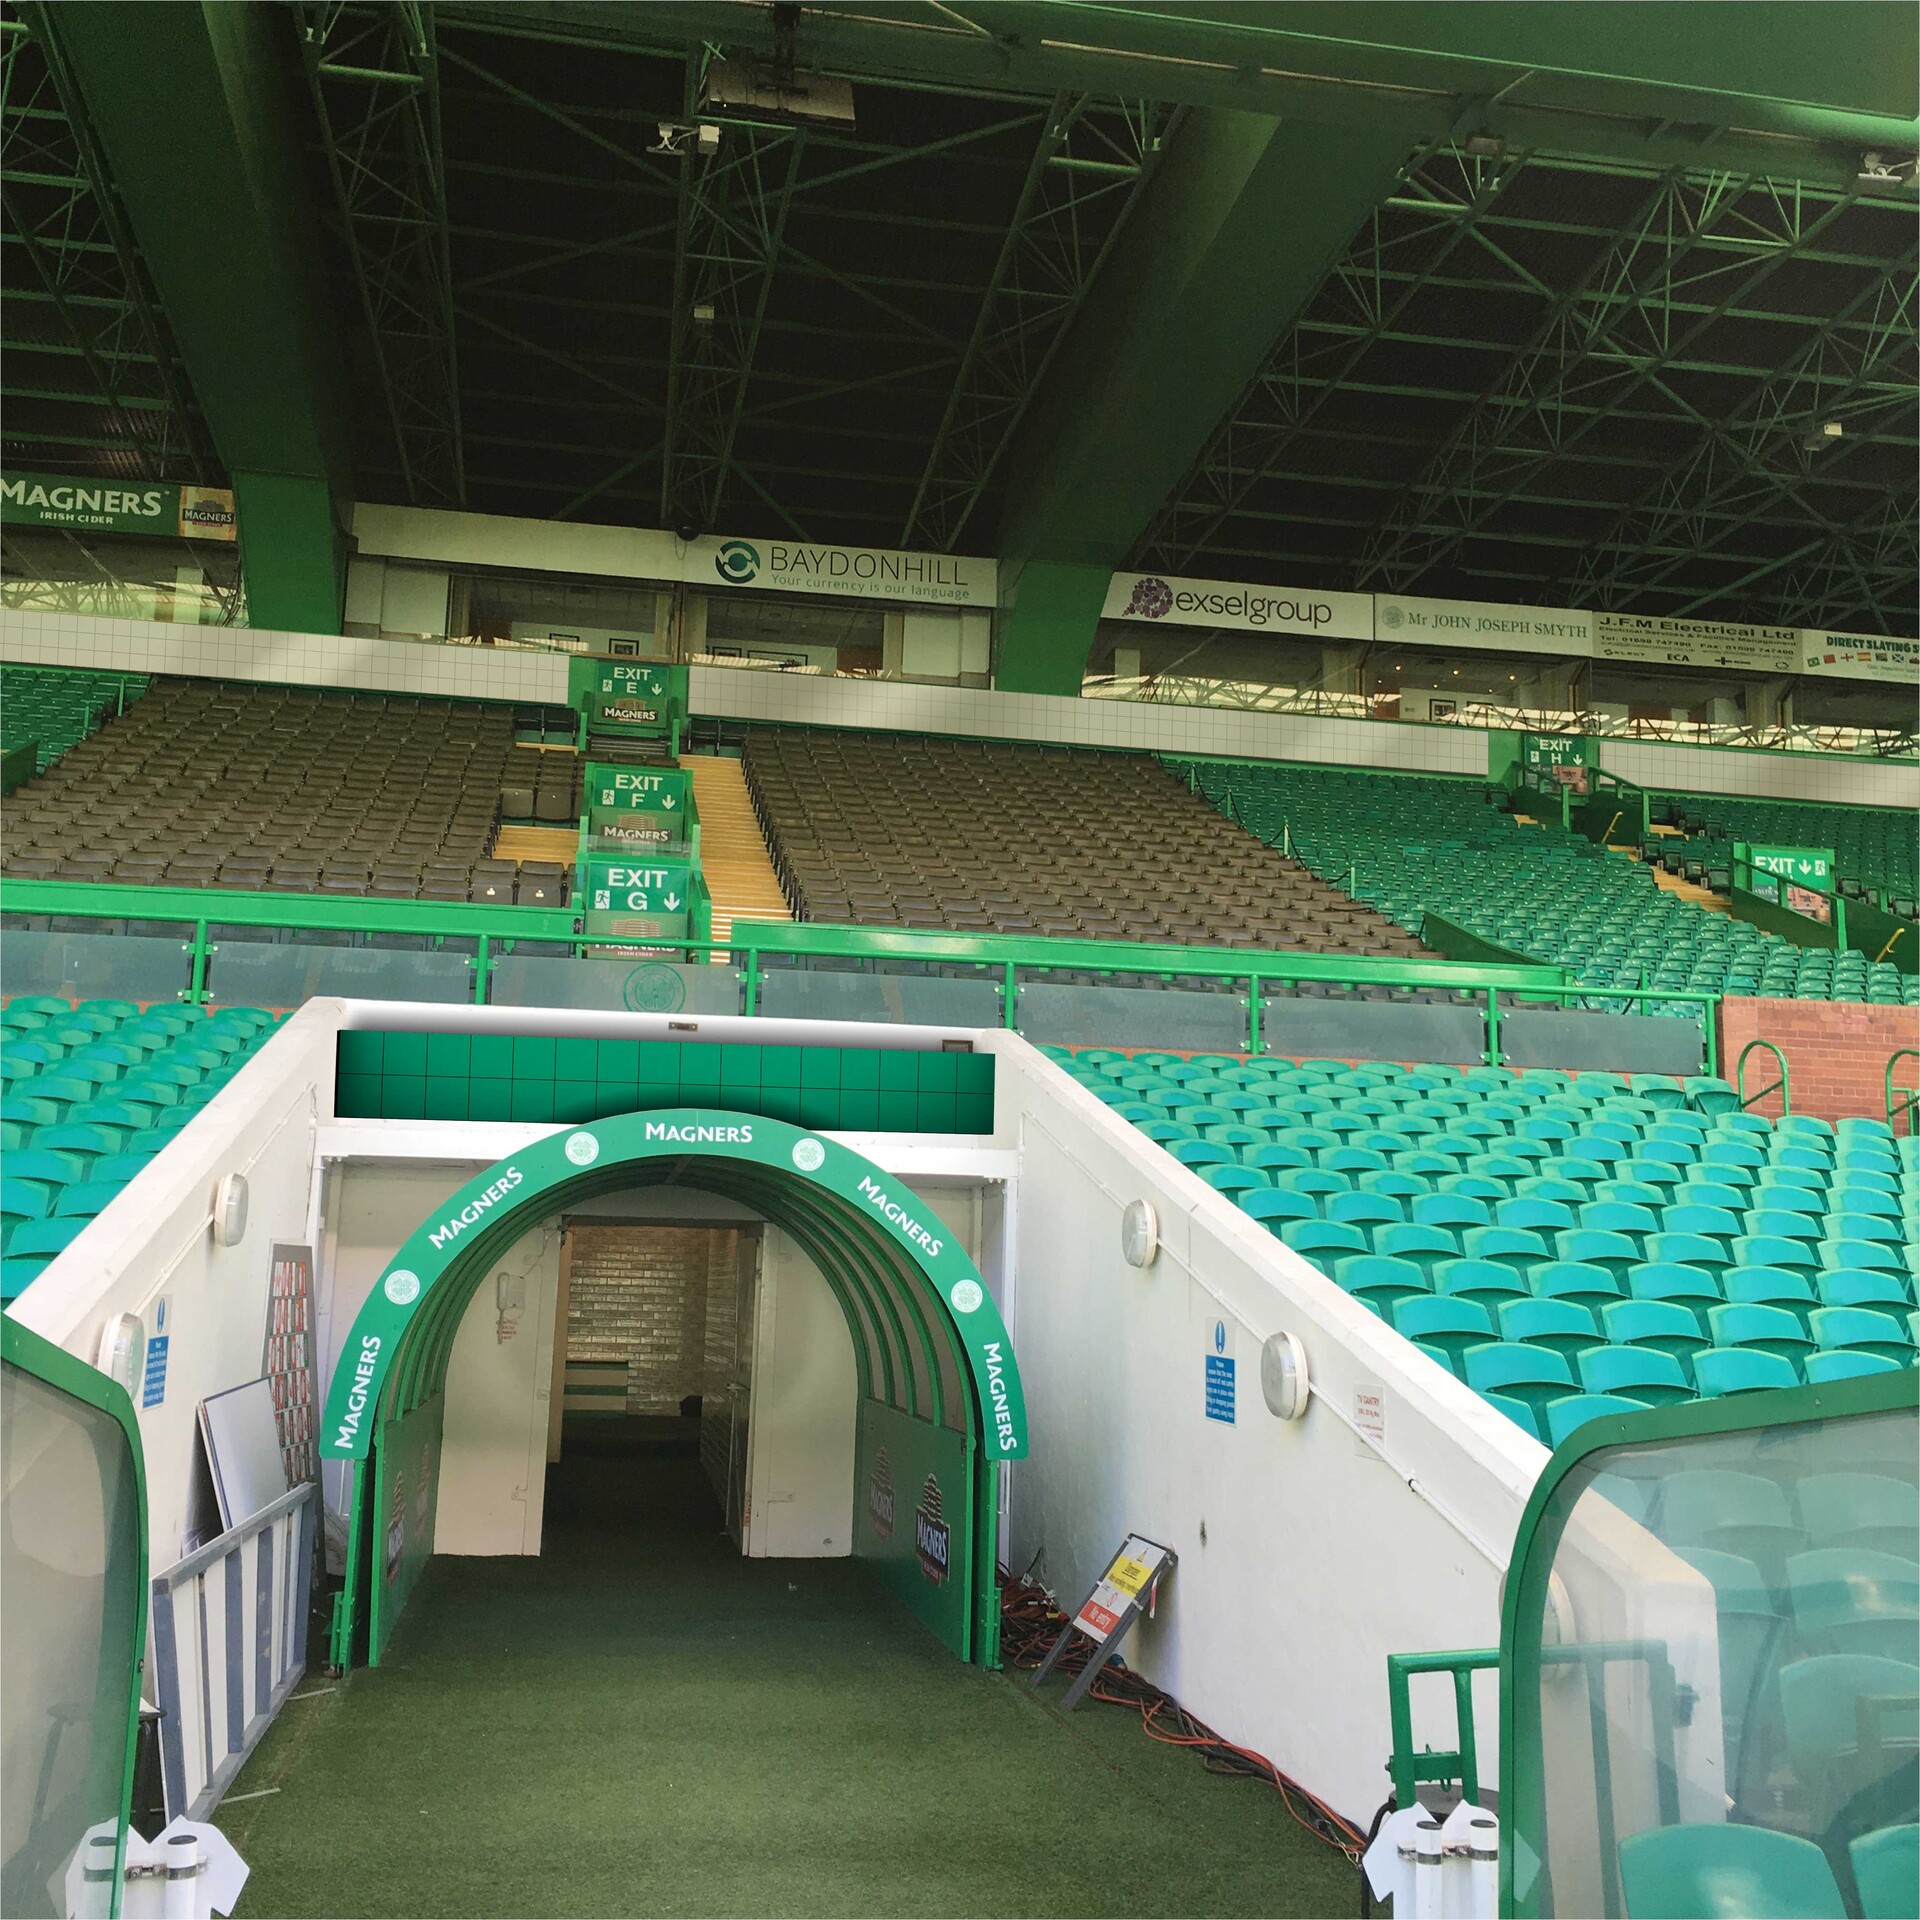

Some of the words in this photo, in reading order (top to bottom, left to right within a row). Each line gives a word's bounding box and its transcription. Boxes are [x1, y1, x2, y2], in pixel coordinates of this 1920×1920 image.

[1, 479, 162, 517] MAGNERS
[39, 511, 75, 523] IRISH
[77, 514, 114, 525] CIDER
[184, 510, 232, 523] MAGNERS
[771, 547, 968, 586] BAYDONHILL
[771, 574, 801, 586] Your
[806, 579, 864, 593] currency
[870, 582, 880, 592] is
[884, 585, 906, 594] our
[911, 585, 970, 600] language
[1175, 591, 1332, 629] exselgroup
[1408, 613, 1427, 626] Mr
[1432, 616, 1471, 629] JOHN
[1475, 619, 1530, 634] JOSEPH
[1534, 623, 1588, 638] SMYTH
[1600, 617, 1652, 629] J.F.M
[1660, 621, 1755, 637] Electrical
[1762, 630, 1795, 641] Ltd
[1826, 636, 1865, 650] DIRECT
[1867, 640, 1911, 653] SLATING
[614, 667, 651, 681] EXIT
[626, 681, 637, 694] E
[604, 707, 656, 720] MAGNERS
[1540, 738, 1573, 752] EXIT
[1551, 753, 1562, 764] H
[615, 773, 663, 791] EXIT
[631, 792, 645, 808] F
[604, 826, 669, 842] MAGNERS
[1754, 855, 1796, 874] EXIT
[608, 868, 669, 889] EXIT
[627, 891, 648, 911] G
[645, 1121, 753, 1144] MAGNERS
[428, 1166, 524, 1250] MAGNERS
[857, 1174, 944, 1258] MAGNERS
[334, 1335, 381, 1449] MAGNERS
[983, 1342, 1017, 1451] MAGNERS
[917, 1513, 947, 1566] MAGNERS
